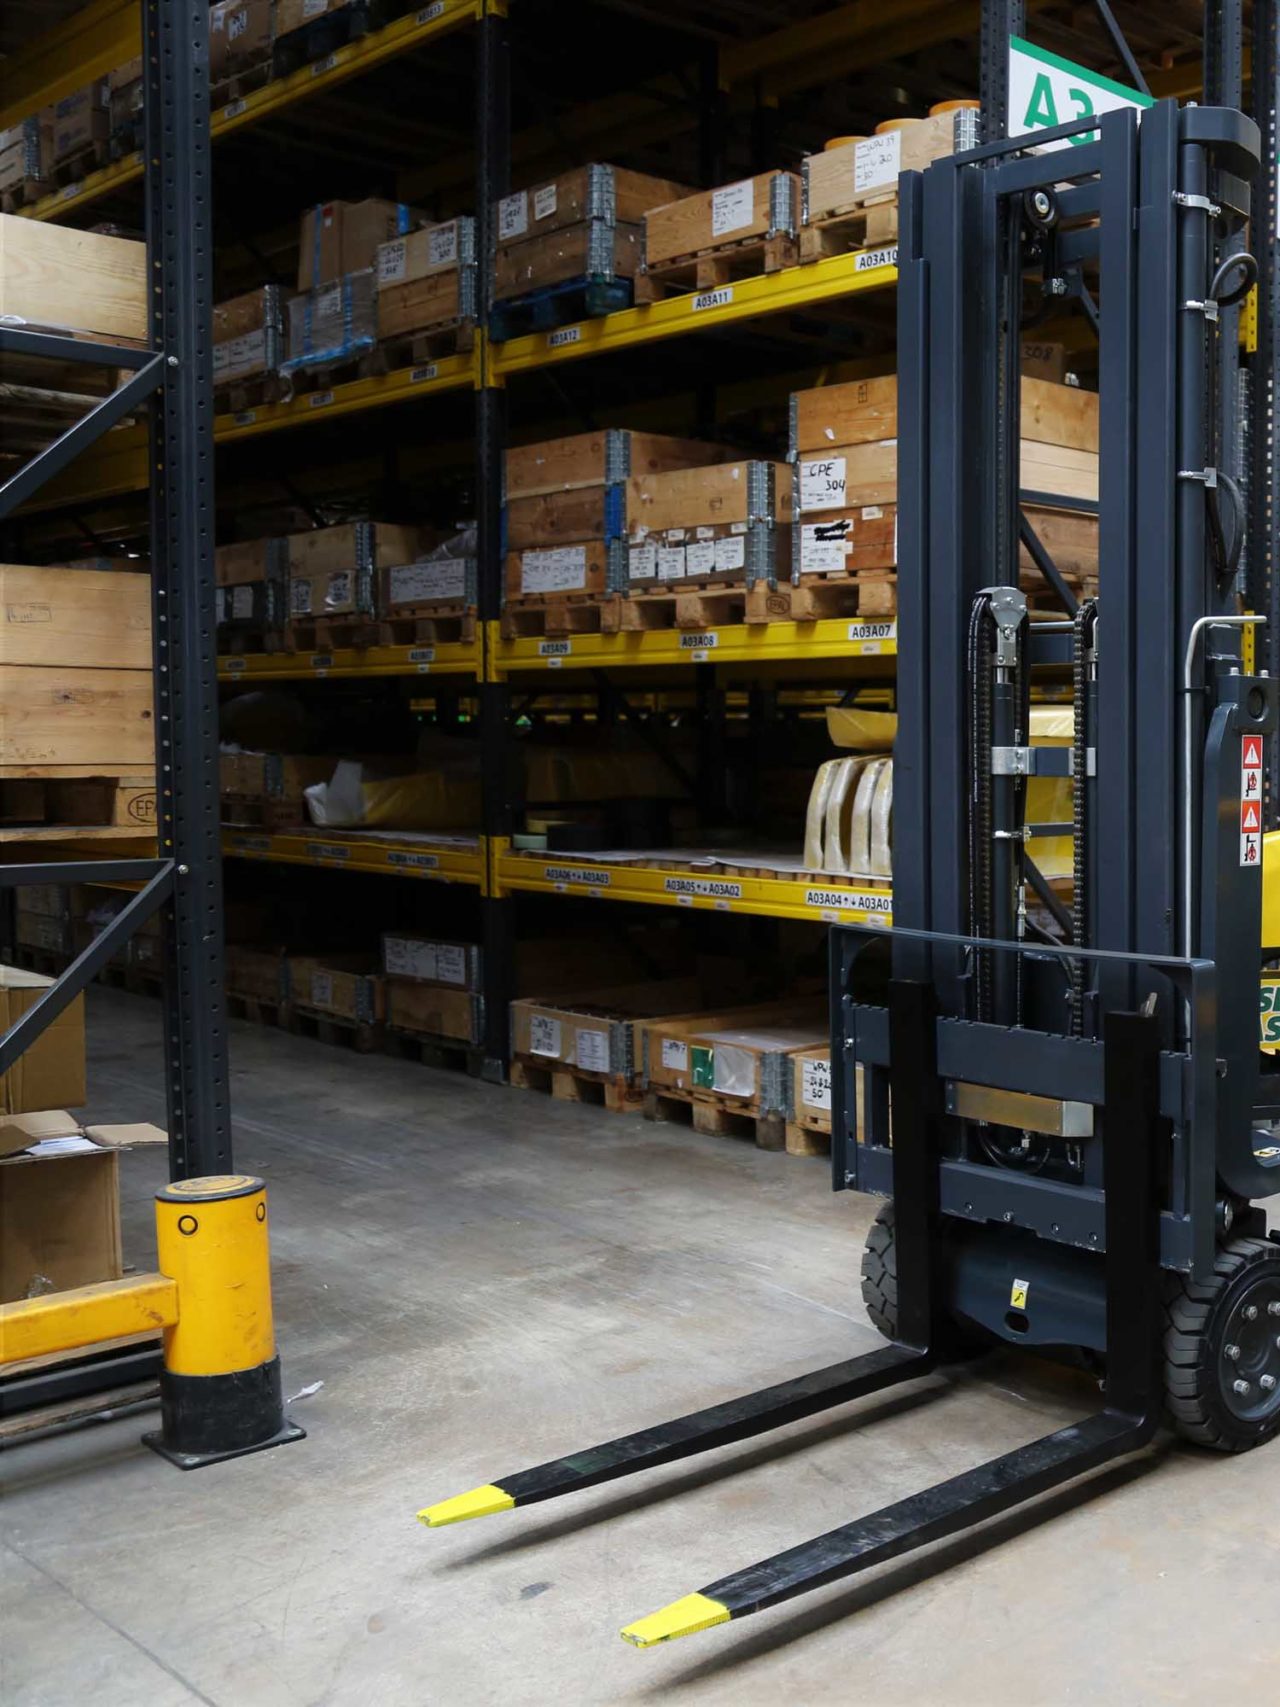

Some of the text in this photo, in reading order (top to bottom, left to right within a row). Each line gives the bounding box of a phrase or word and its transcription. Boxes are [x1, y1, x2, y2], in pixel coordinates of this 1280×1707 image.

[1023, 71, 1095, 147] A3
[859, 248, 899, 269] A03A10
[695, 291, 729, 309] A03A11
[810, 461, 836, 478] CPE
[825, 479, 847, 493] 304
[852, 624, 892, 639] A03A07
[681, 635, 715, 648] A03A08
[666, 878, 741, 898] A03A05 A03A02
[807, 891, 894, 911] A03A04 A03A0
